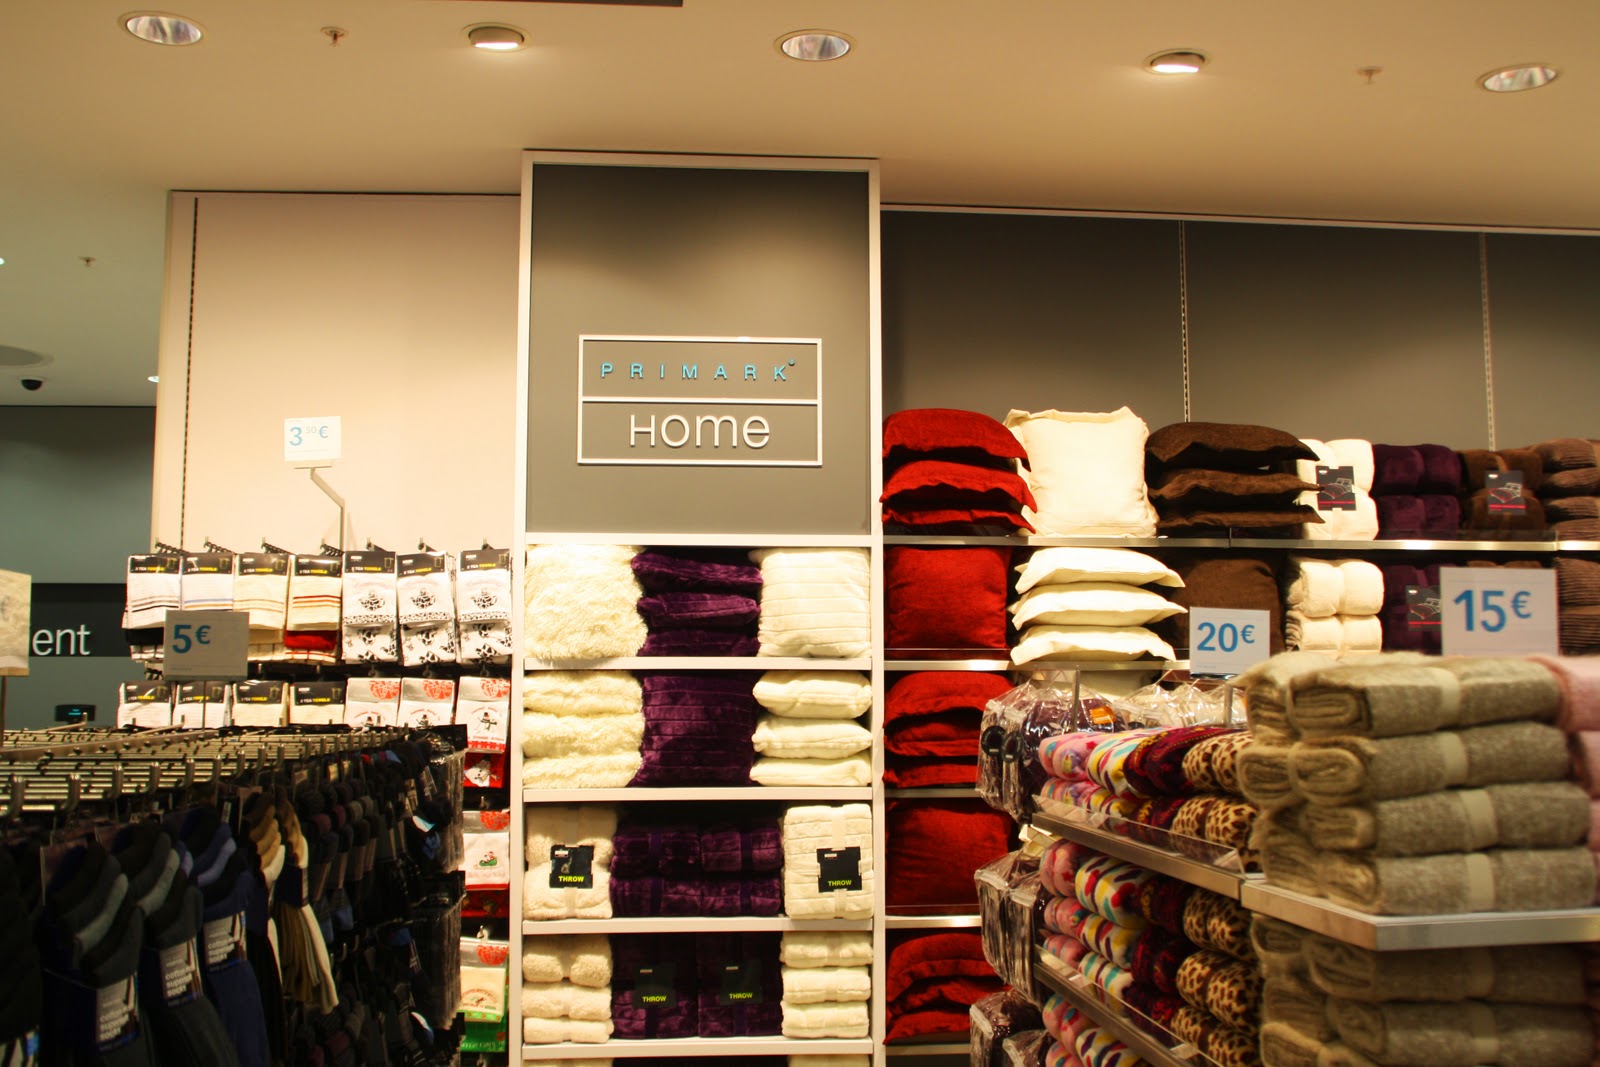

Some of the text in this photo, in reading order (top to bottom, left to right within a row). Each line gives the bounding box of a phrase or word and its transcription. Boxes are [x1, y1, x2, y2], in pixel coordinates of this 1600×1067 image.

[600, 362, 787, 381] PRIMARK
[32, 624, 91, 656] ent
[558, 875, 585, 883] THROW
[827, 879, 853, 888] THROW
[642, 995, 667, 1003] THROW
